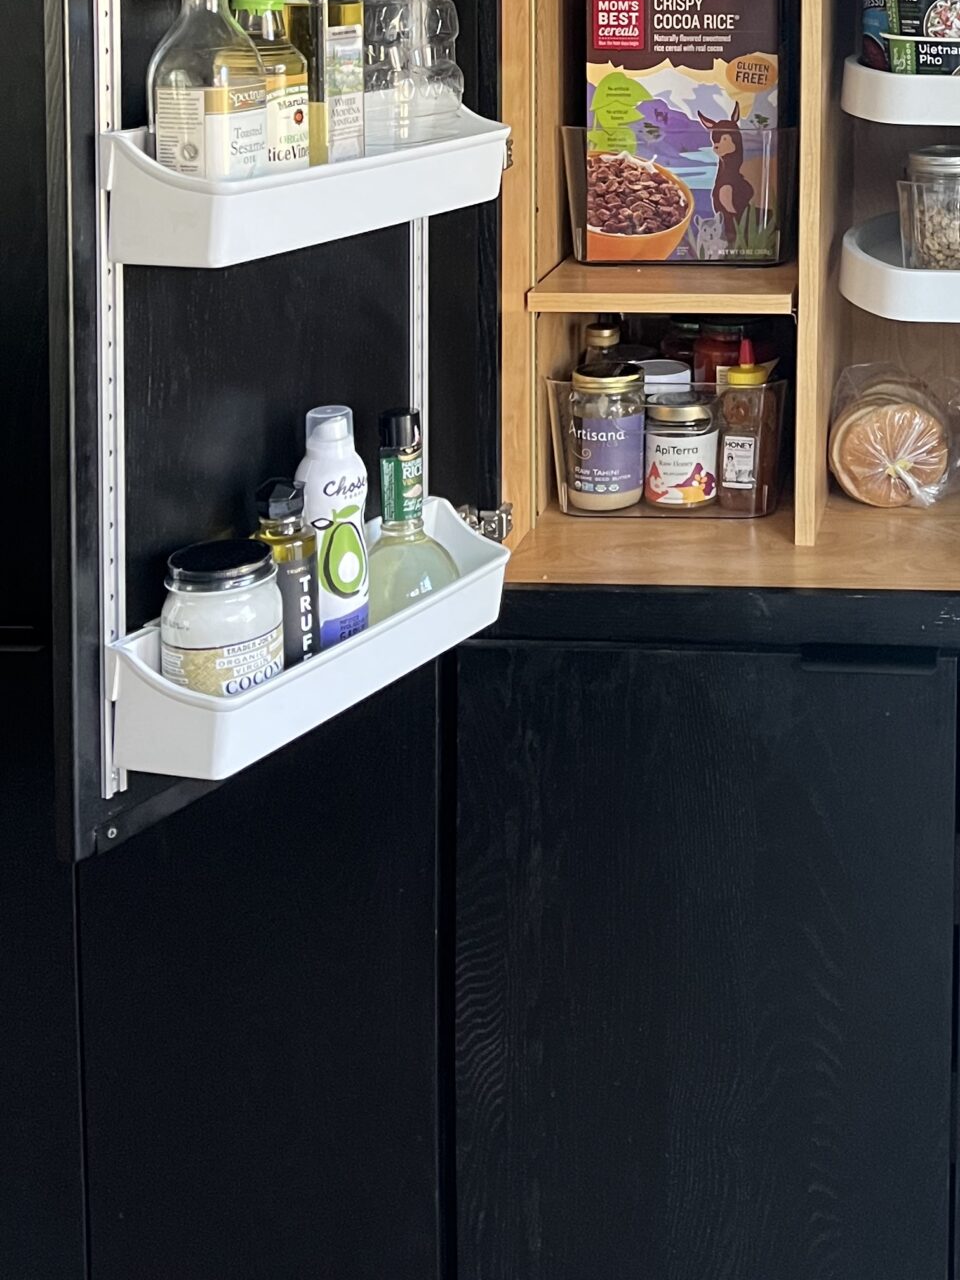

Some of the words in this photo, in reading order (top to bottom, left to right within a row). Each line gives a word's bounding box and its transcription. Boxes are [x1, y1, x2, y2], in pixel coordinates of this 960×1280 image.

[598, 1, 639, 11] MOM'S
[598, 12, 639, 25] BEST
[654, 14, 700, 29] COCOA
[598, 25, 639, 36] cereals
[654, 34, 678, 43] Naturally
[680, 34, 701, 42] flavored
[919, 55, 942, 65] Pho
[737, 61, 770, 73] GLUTEN
[735, 71, 768, 85] FREE!
[569, 422, 625, 441] Artisana
[655, 444, 698, 457] ApiTerra
[725, 441, 753, 449] HONEY
[673, 460, 693, 468] Honey
[575, 467, 591, 475] RAW
[592, 468, 619, 476] TAHINI
[227, 642, 256, 655] TRADER
[218, 651, 265, 667] ORGANIC
[235, 657, 269, 674] VIRGIN
